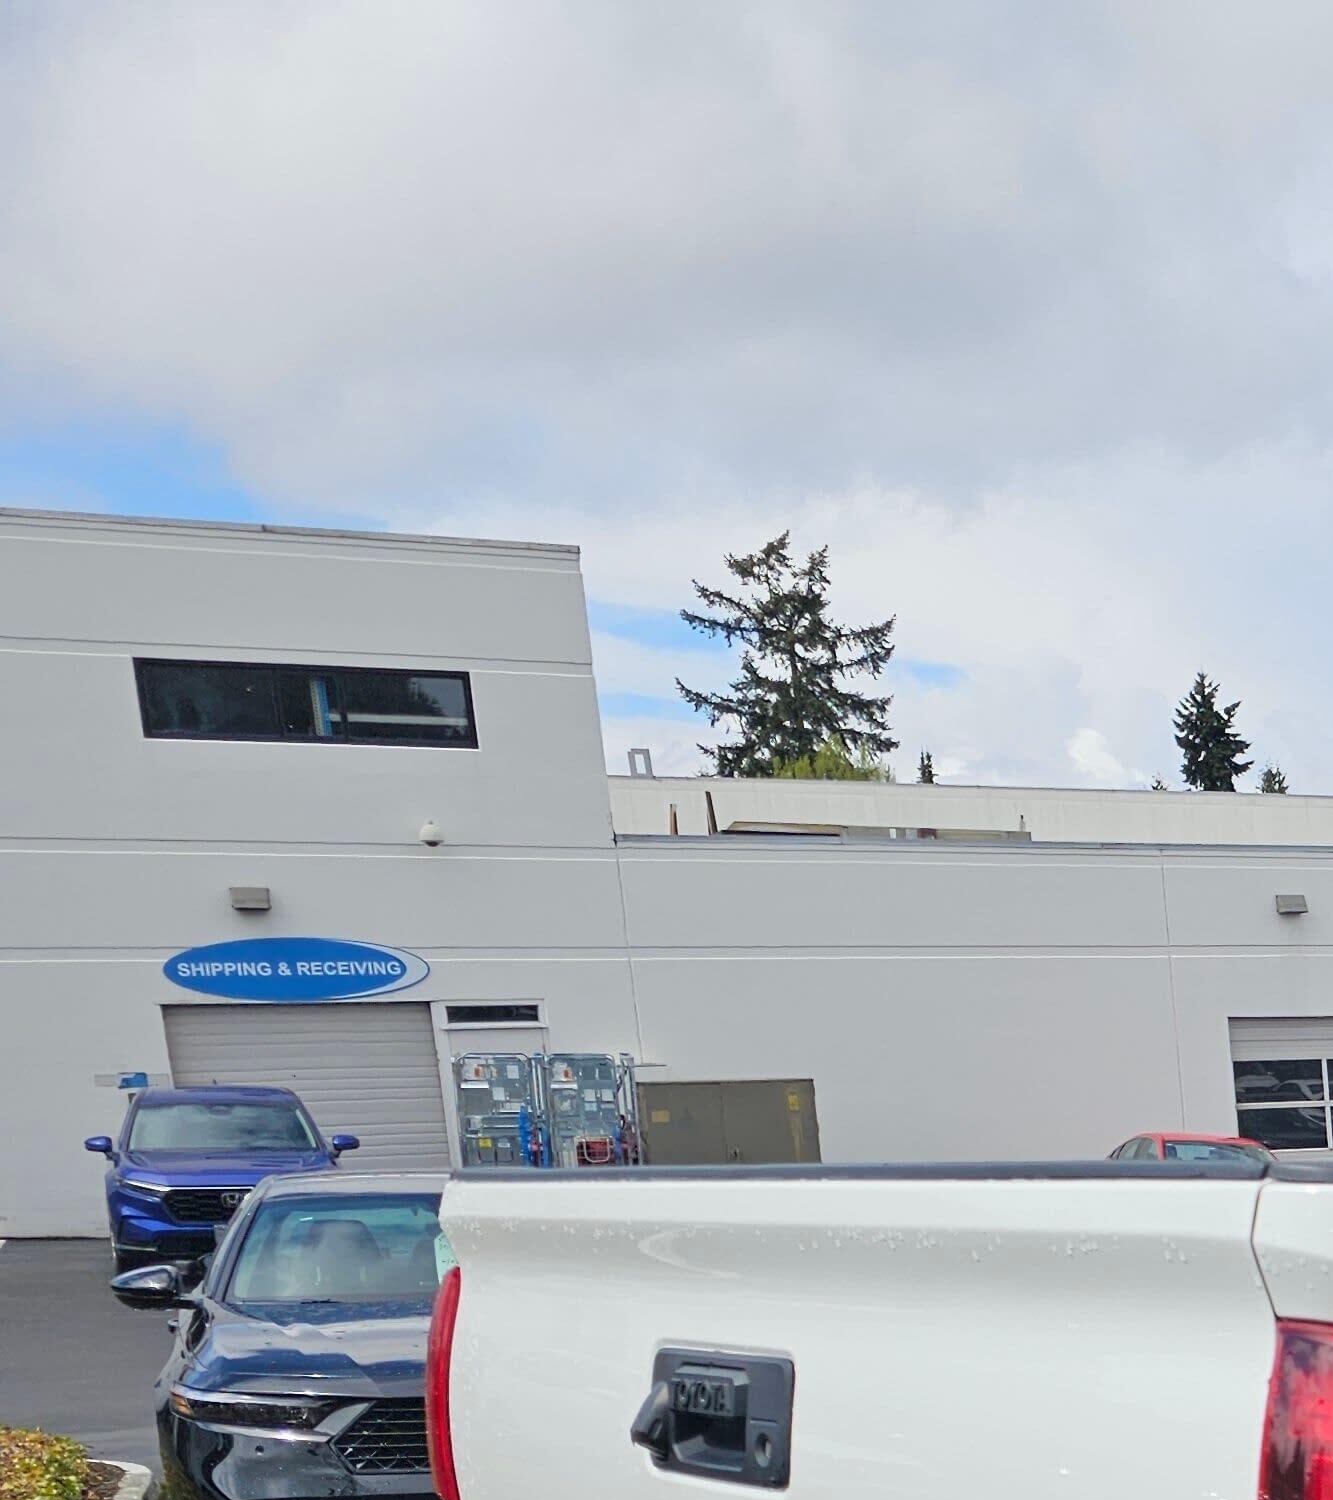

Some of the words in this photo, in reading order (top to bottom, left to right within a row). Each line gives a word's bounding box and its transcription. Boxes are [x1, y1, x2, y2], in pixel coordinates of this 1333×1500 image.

[177, 962, 272, 977] SHIPPING
[277, 961, 293, 977] &
[297, 961, 402, 976] RECEIVING
